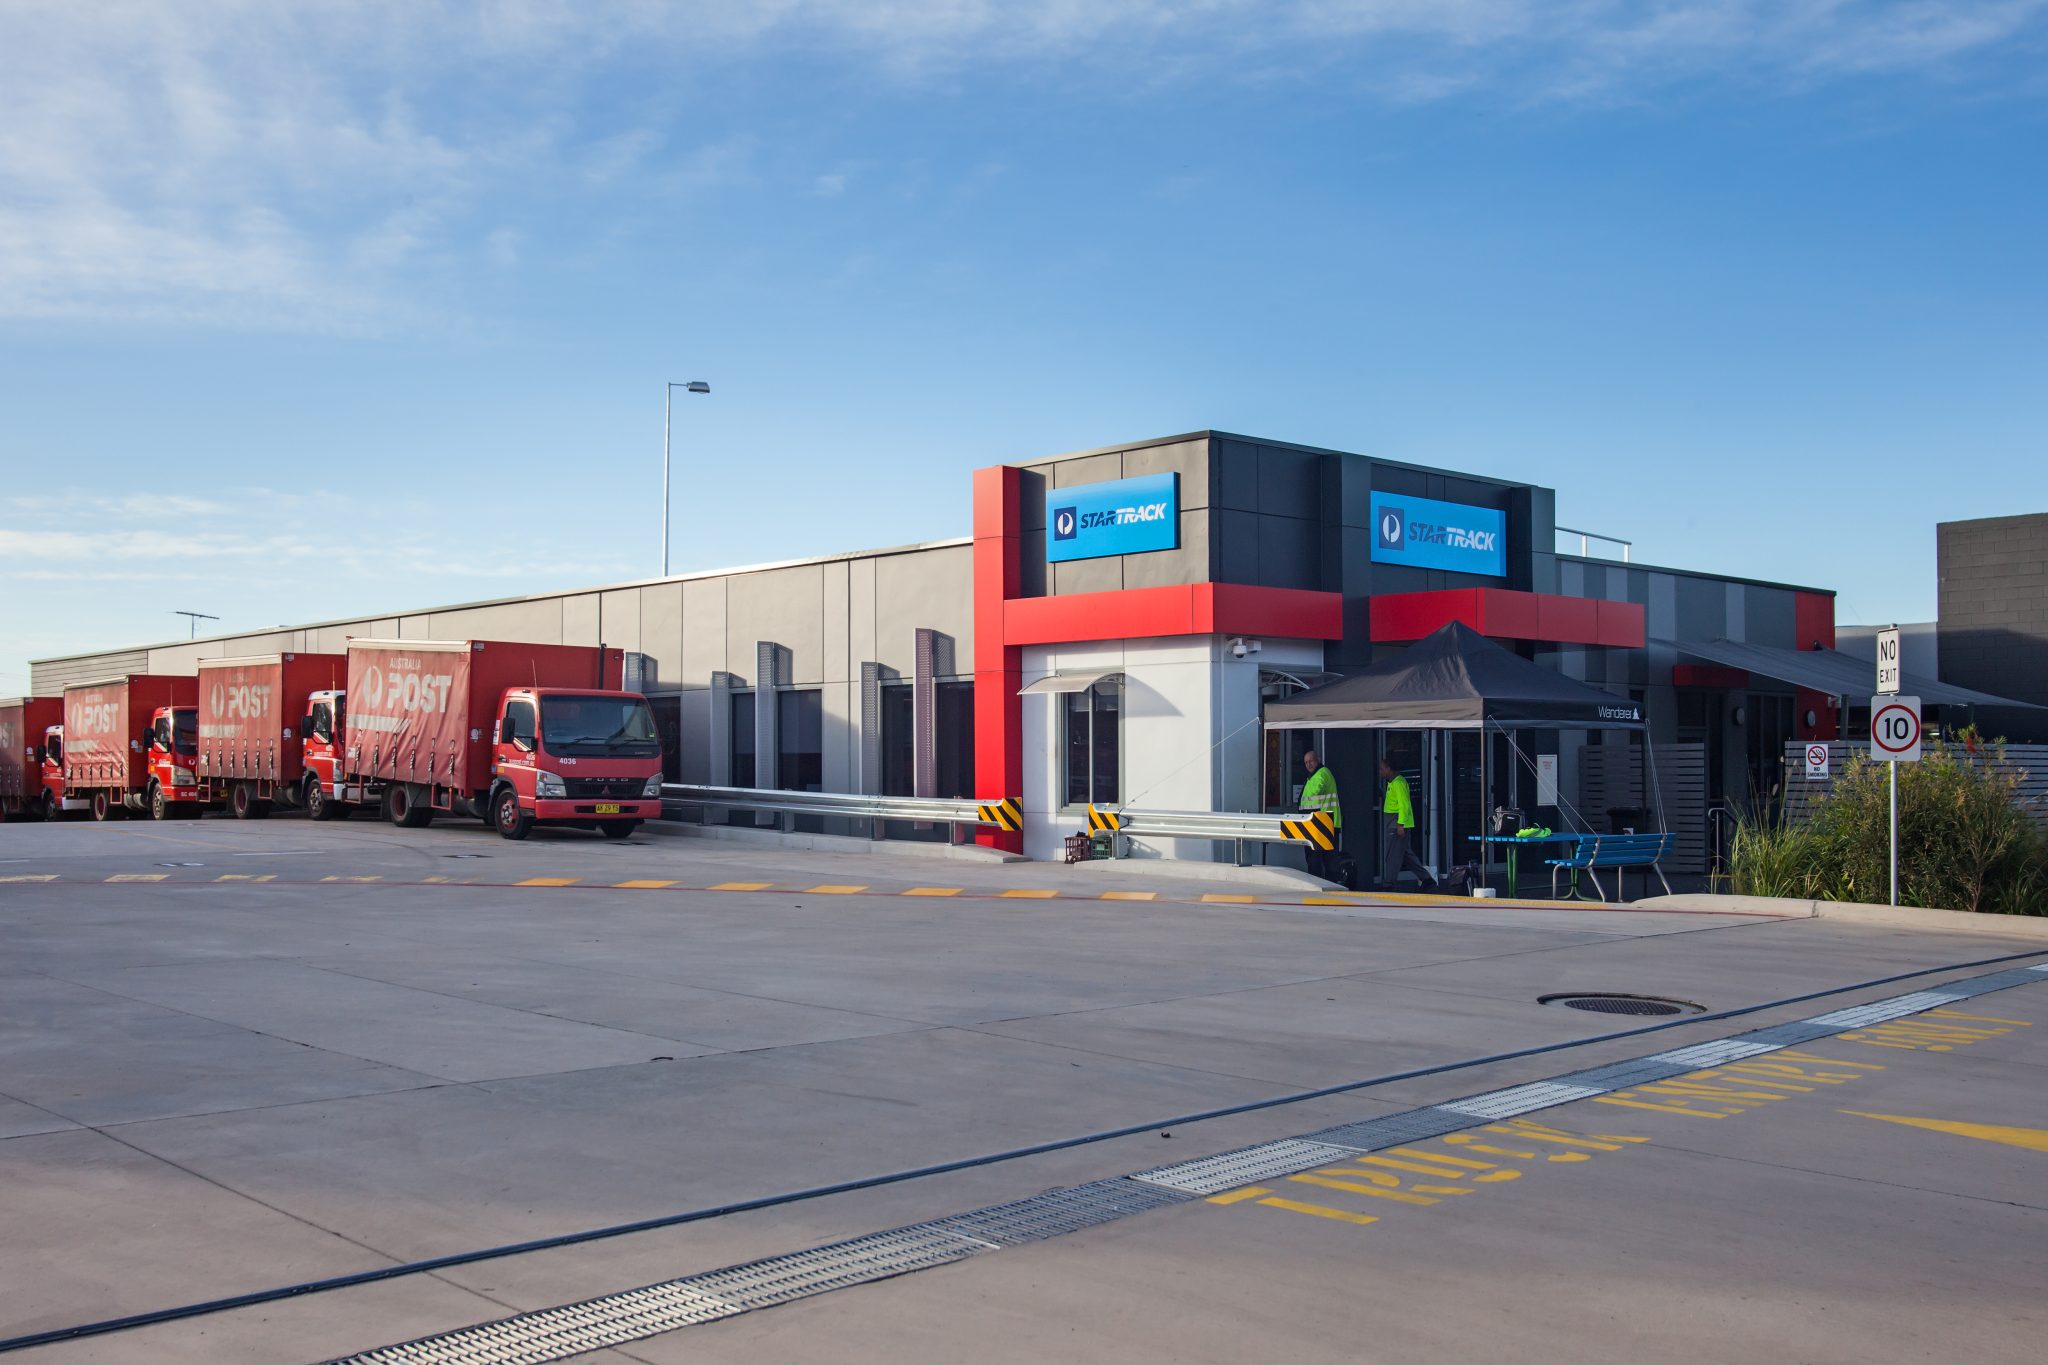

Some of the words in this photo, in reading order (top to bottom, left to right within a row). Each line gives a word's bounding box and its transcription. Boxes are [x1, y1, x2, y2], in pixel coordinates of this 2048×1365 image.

[1080, 503, 1167, 529] STARTRACK
[1408, 522, 1497, 552] STARTRACK
[1880, 640, 1896, 662] NO
[389, 657, 421, 670] AUSTRALIA
[1880, 668, 1897, 684] EXIT
[227, 684, 272, 718] POST
[387, 672, 452, 713] POST
[81, 703, 119, 735] POST
[1598, 705, 1632, 719] Wanderer
[1884, 717, 1909, 740] 10
[559, 757, 577, 765] 4036
[1206, 1119, 1651, 1225] TRUCK
[1592, 1049, 1886, 1119] ENTRY
[1837, 1008, 2033, 1051] ONLY
